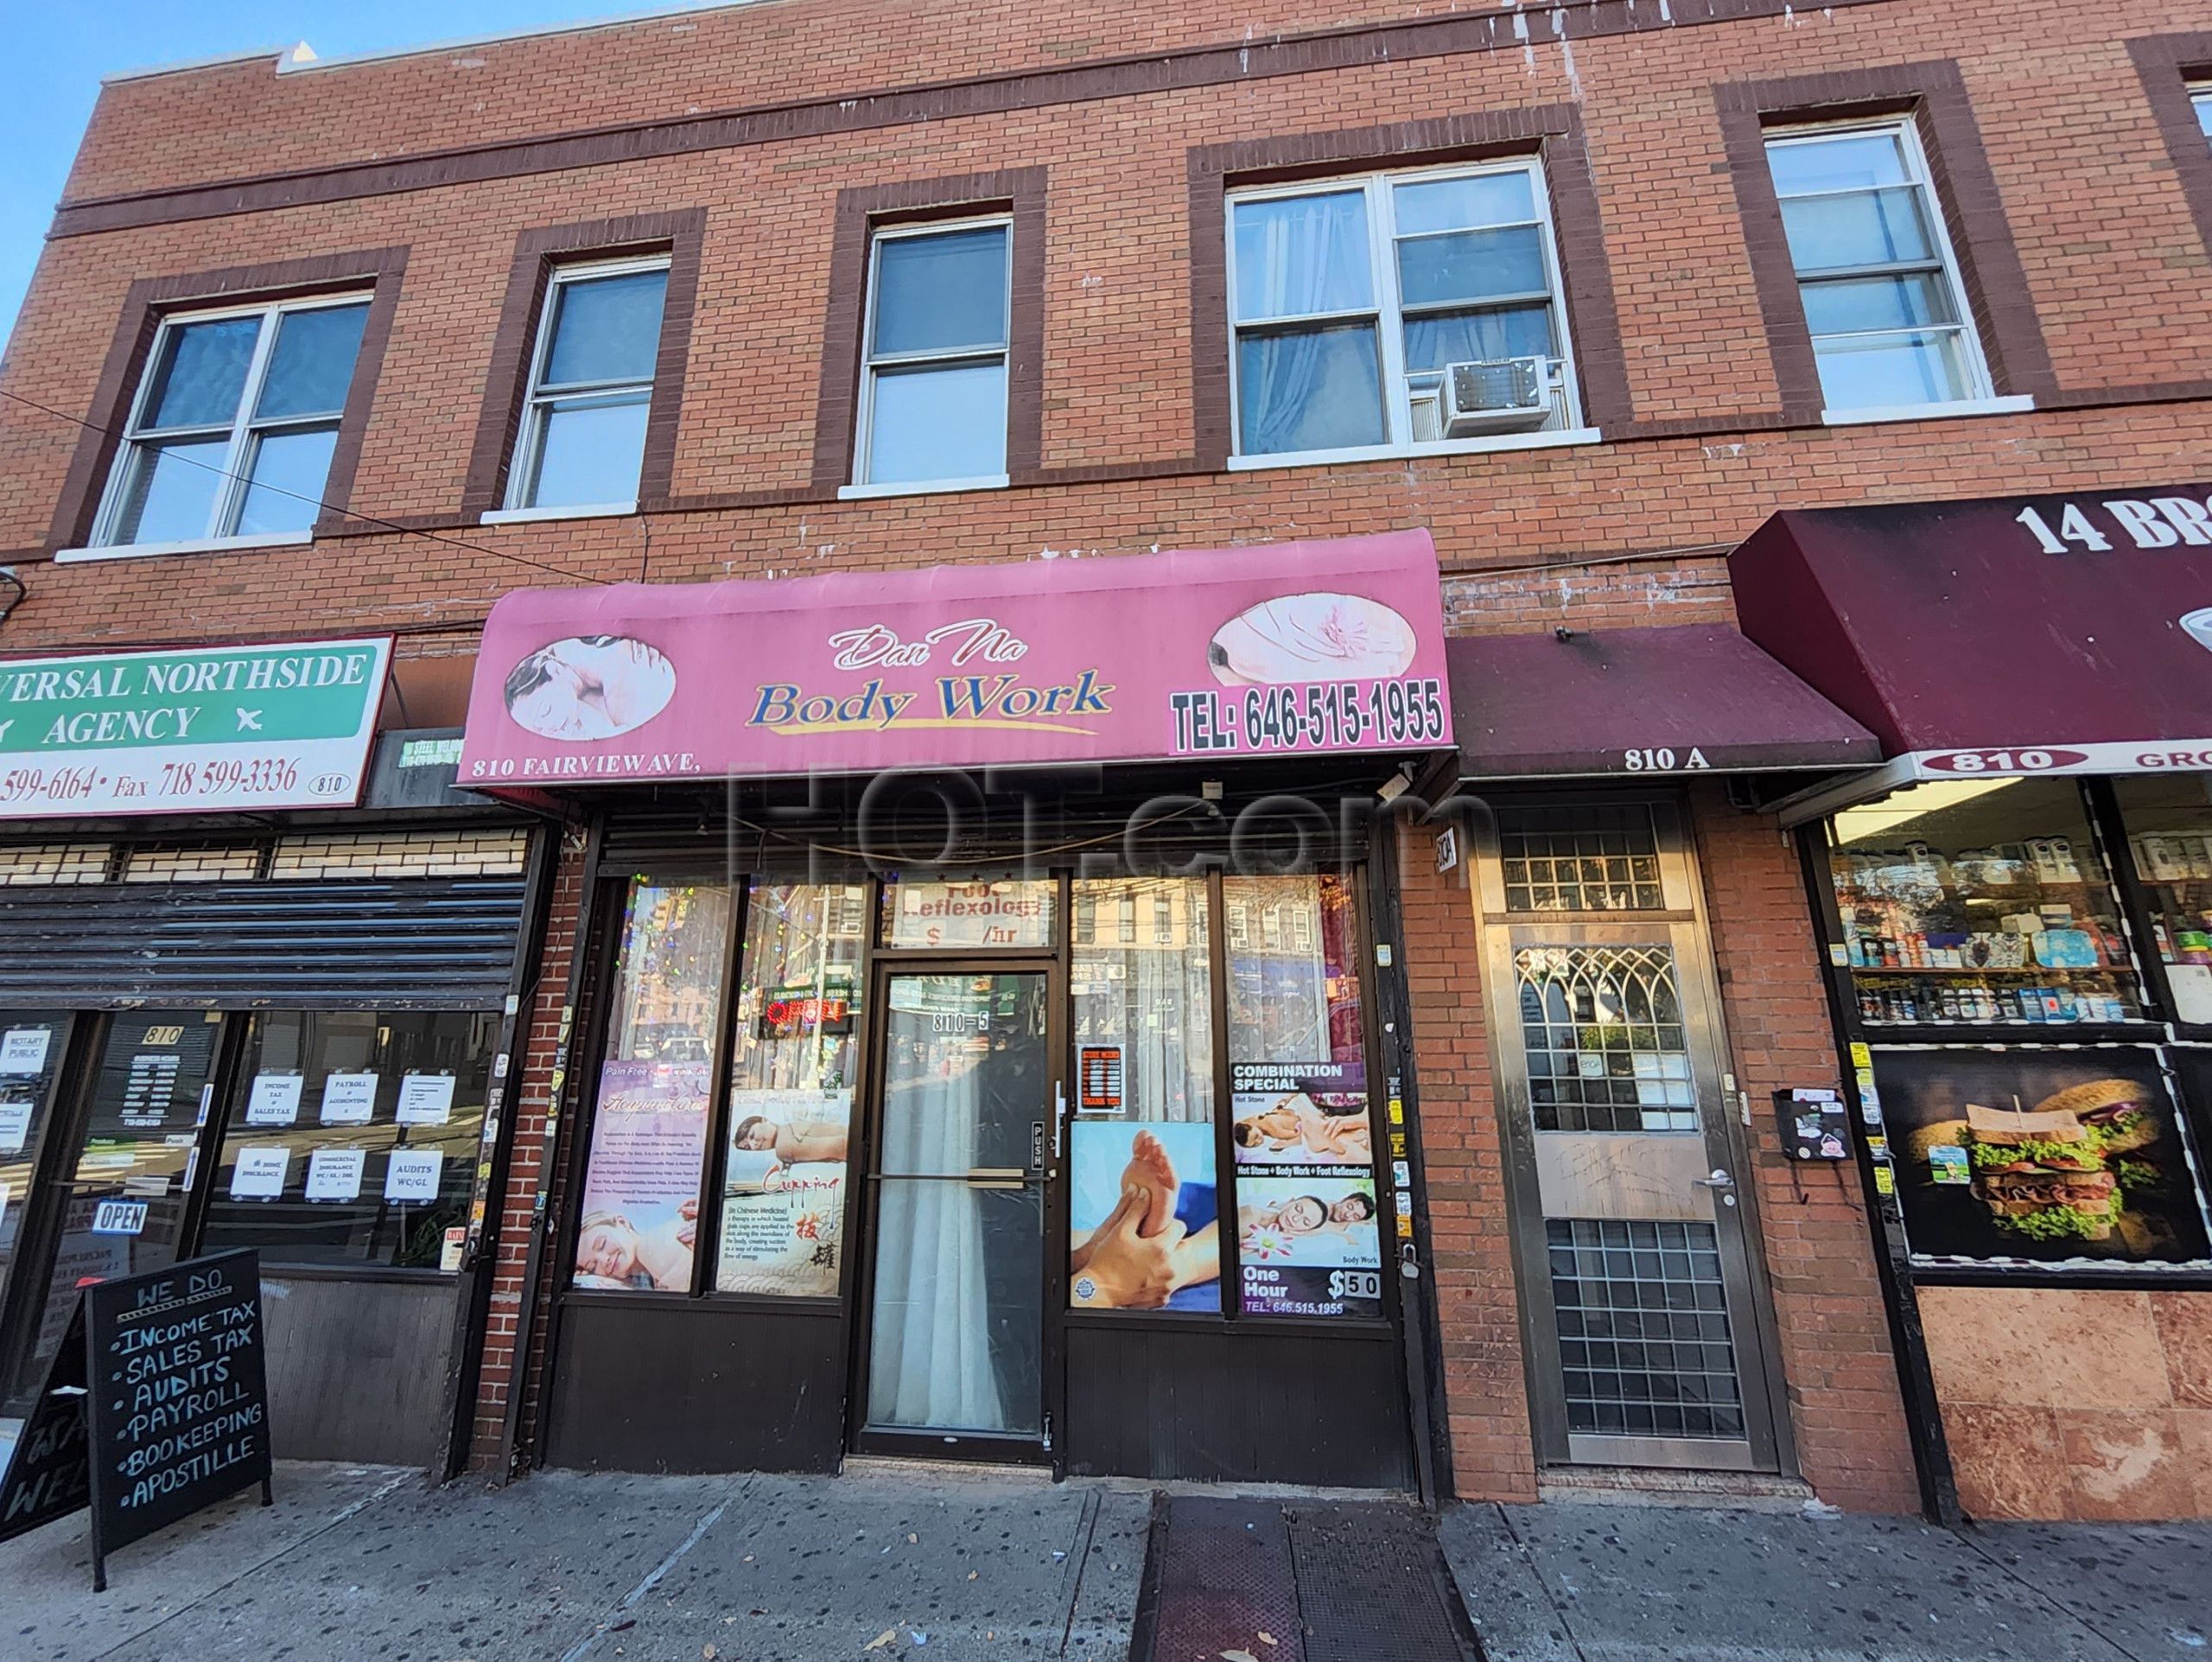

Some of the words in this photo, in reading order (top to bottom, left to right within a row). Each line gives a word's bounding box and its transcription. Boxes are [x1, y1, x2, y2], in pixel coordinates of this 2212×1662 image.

[2016, 503, 2113, 553] 14
[2102, 494, 2212, 548] BR
[829, 624, 931, 670] Dan
[925, 619, 1027, 666] Na
[142, 654, 367, 695] NORTHSIDE
[744, 678, 918, 731] Body
[937, 668, 1116, 720] Work
[41, 707, 201, 744] AGENCY
[1170, 691, 1236, 752] TEL:
[1244, 679, 1446, 750] 646-515-1955
[472, 760, 515, 777] 810
[524, 755, 645, 775] FAIRVIEW
[647, 753, 701, 774] AVE,
[1625, 748, 1675, 771] 810
[1684, 747, 1711, 768] A
[1951, 751, 2053, 772] 810
[0, 766, 98, 801] 599-6164
[112, 776, 149, 798] Fax
[159, 762, 197, 796] 718
[199, 757, 302, 795] 599-3336
[316, 776, 342, 793] 810
[904, 898, 1041, 918] eflexology
[926, 927, 941, 946] $
[146, 1028, 180, 1042] 810
[605, 1067, 626, 1076] Pain
[628, 1067, 648, 1076] Free
[1233, 1064, 1342, 1077] COMBINATION
[1234, 1078, 1300, 1091] SPECIAL
[397, 1178, 428, 1188] WC/GL
[1237, 1166, 1249, 1175] Hot
[1250, 1166, 1268, 1175] Stone
[1276, 1166, 1292, 1177] Body
[1294, 1166, 1310, 1175] Work
[1317, 1167, 1331, 1175] Foot
[1332, 1167, 1370, 1178] Reflexology
[763, 1165, 840, 1210] Cupping
[100, 1205, 145, 1230] OPEN
[1343, 1256, 1359, 1265] Body
[1243, 1266, 1280, 1282] One
[137, 1282, 175, 1308] WE
[189, 1269, 222, 1294] DO
[1244, 1283, 1288, 1297] Hour
[1245, 1302, 1270, 1313] TEL:
[1273, 1302, 1344, 1315] 646.515.1955
[119, 1313, 213, 1355] INCOME
[216, 1301, 256, 1327] TAX
[126, 1340, 201, 1384] SALES
[210, 1323, 254, 1353] TAX
[134, 1355, 231, 1412] AUDITS
[130, 1382, 250, 1442] PAYROLL
[127, 1403, 262, 1477] BOOKEEPING
[132, 1435, 255, 1507] APOSTILLE
